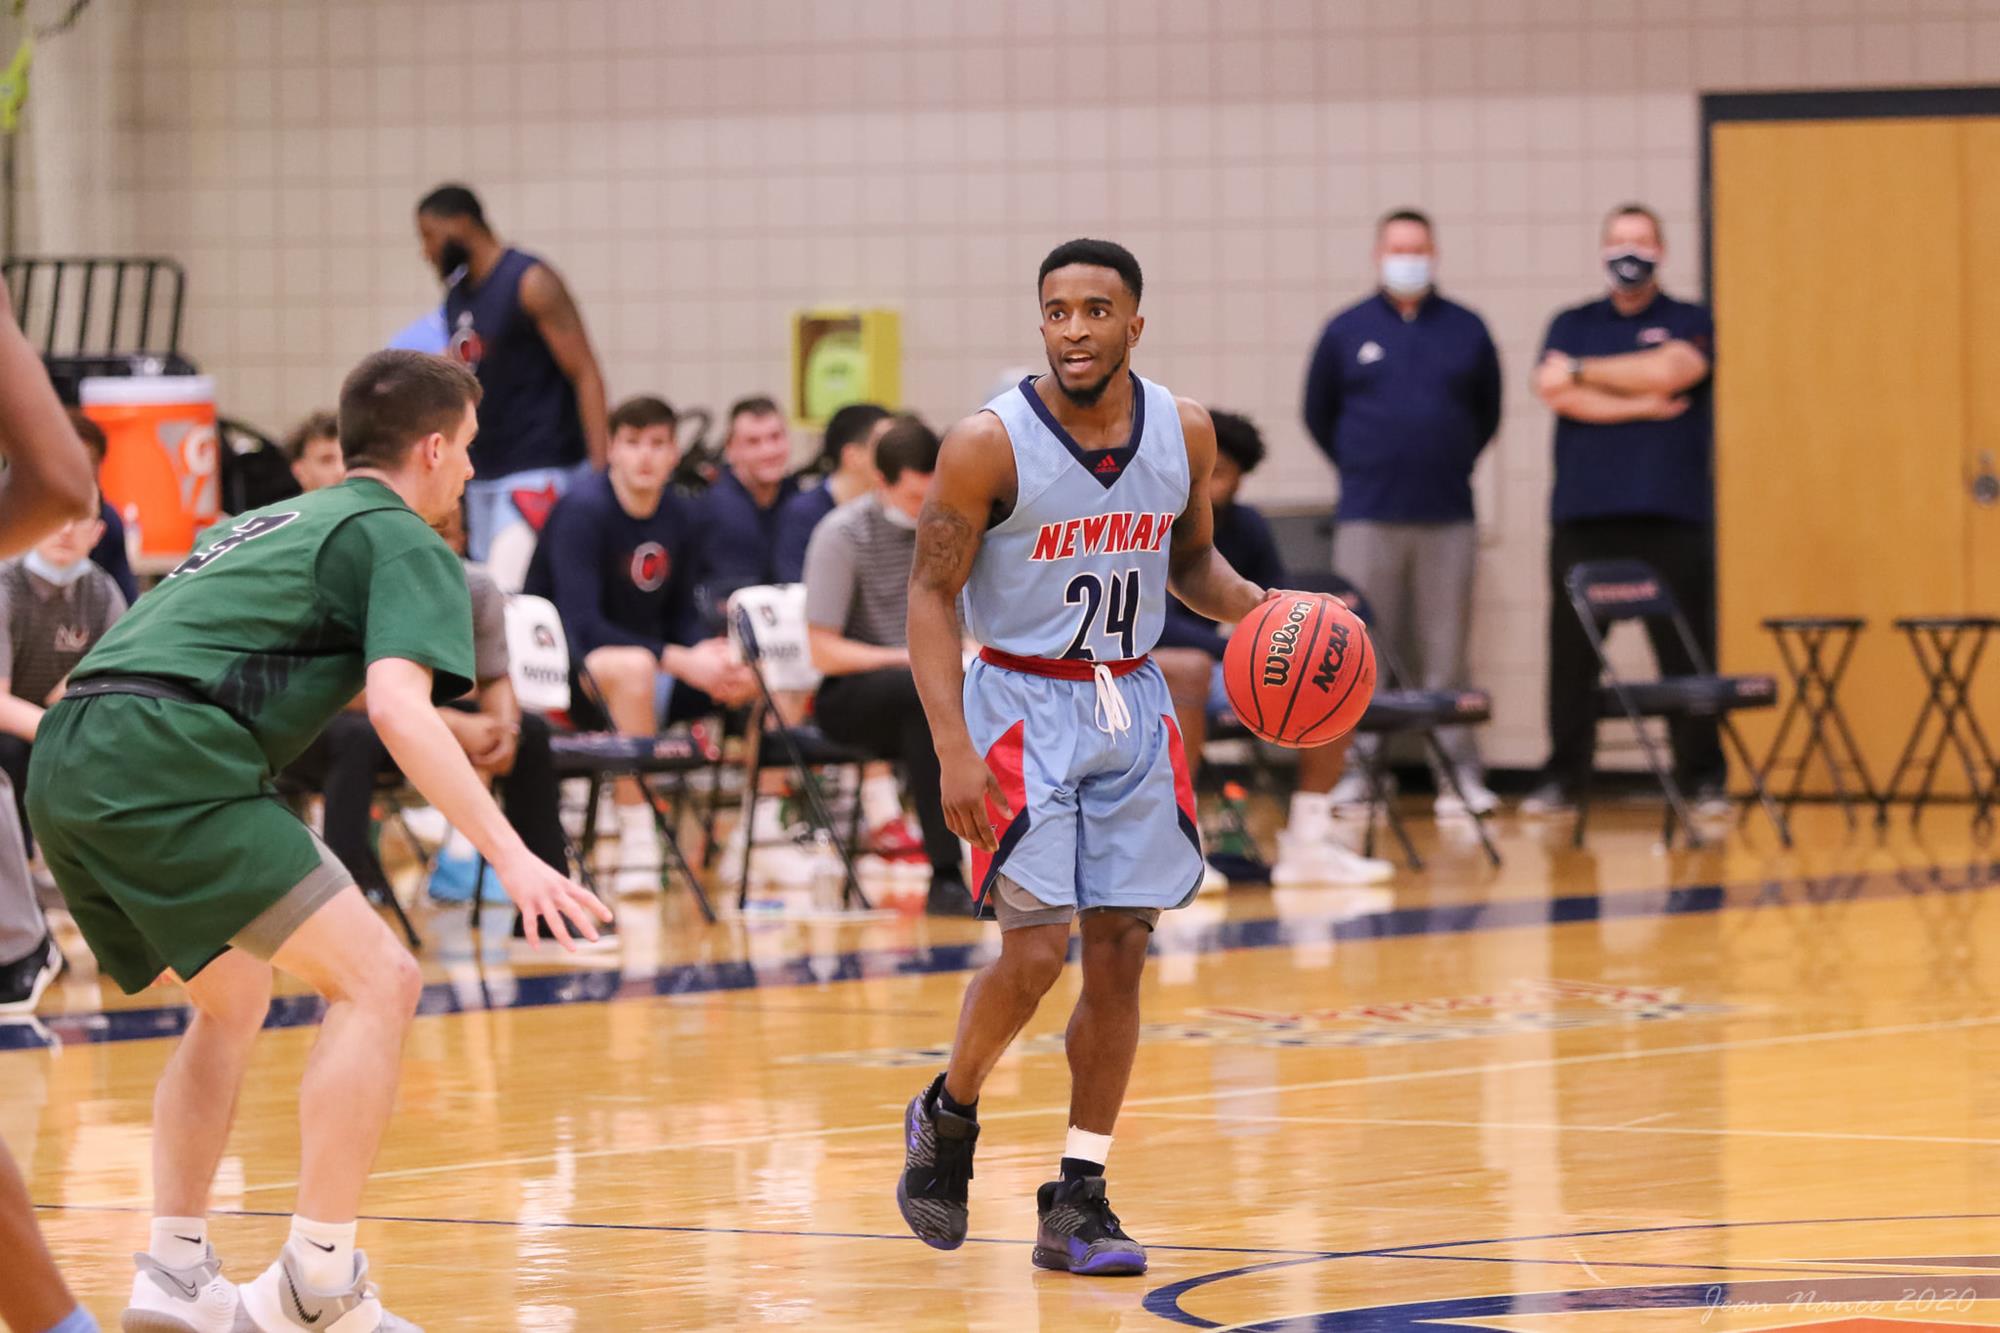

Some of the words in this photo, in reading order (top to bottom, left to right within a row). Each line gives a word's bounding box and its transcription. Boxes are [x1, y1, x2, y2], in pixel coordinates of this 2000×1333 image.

[1055, 568, 1140, 662] 24
[1263, 600, 1315, 688] Wilson
[1312, 622, 1350, 693] NCAA
